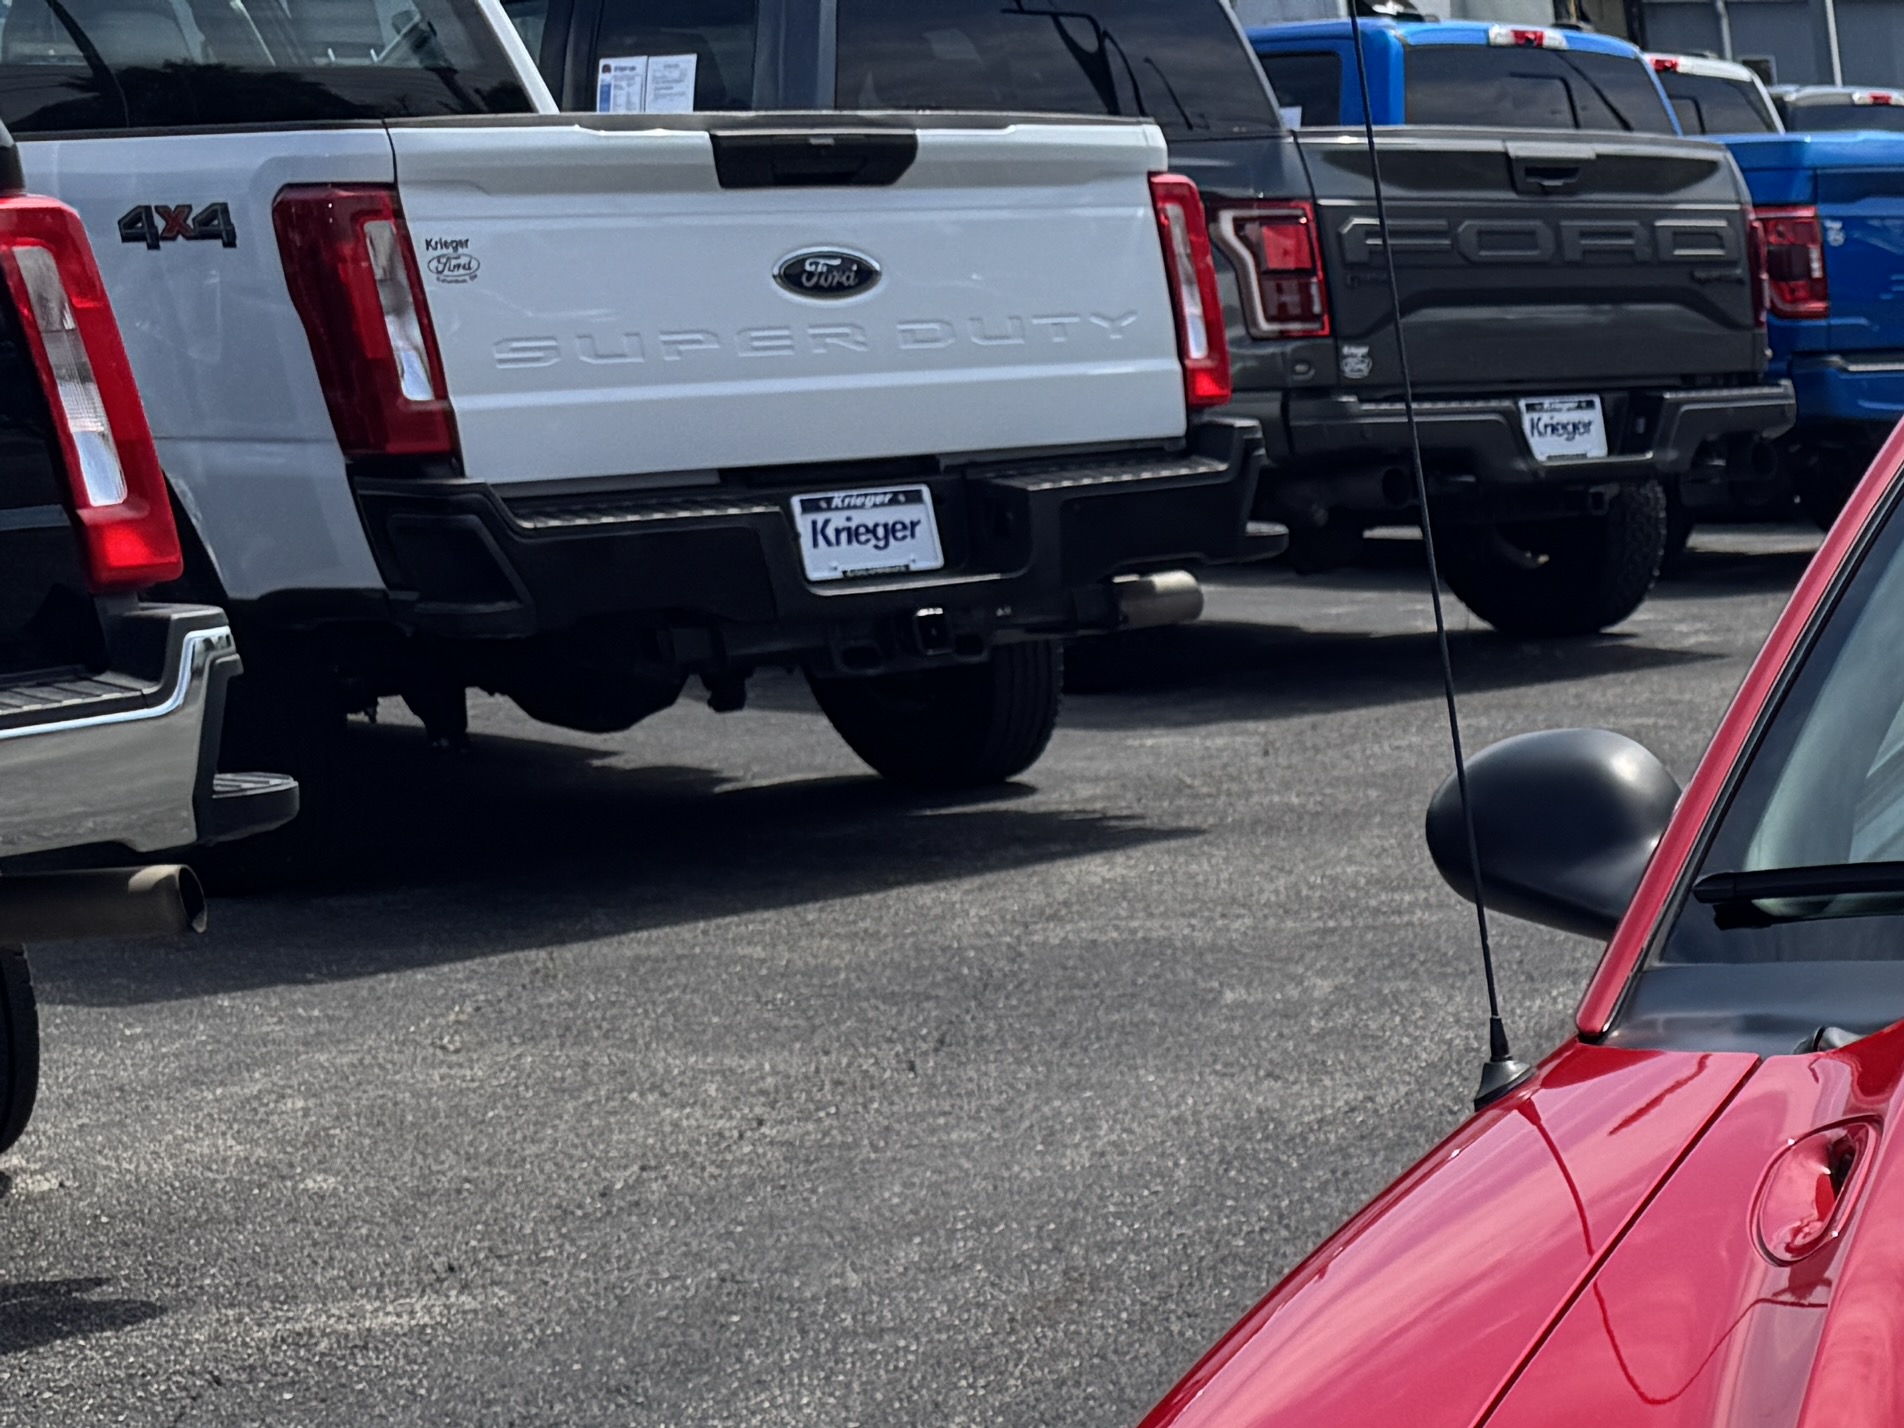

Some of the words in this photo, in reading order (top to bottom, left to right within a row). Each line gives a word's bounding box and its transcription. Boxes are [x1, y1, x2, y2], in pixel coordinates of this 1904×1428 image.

[425, 237, 469, 253] Krieger
[1339, 217, 1739, 264] FORD
[802, 257, 858, 288] Ford
[493, 321, 869, 369] SUPER
[896, 311, 1138, 350] DUTY
[831, 492, 893, 509] Krieger
[811, 516, 921, 551] Krieger
